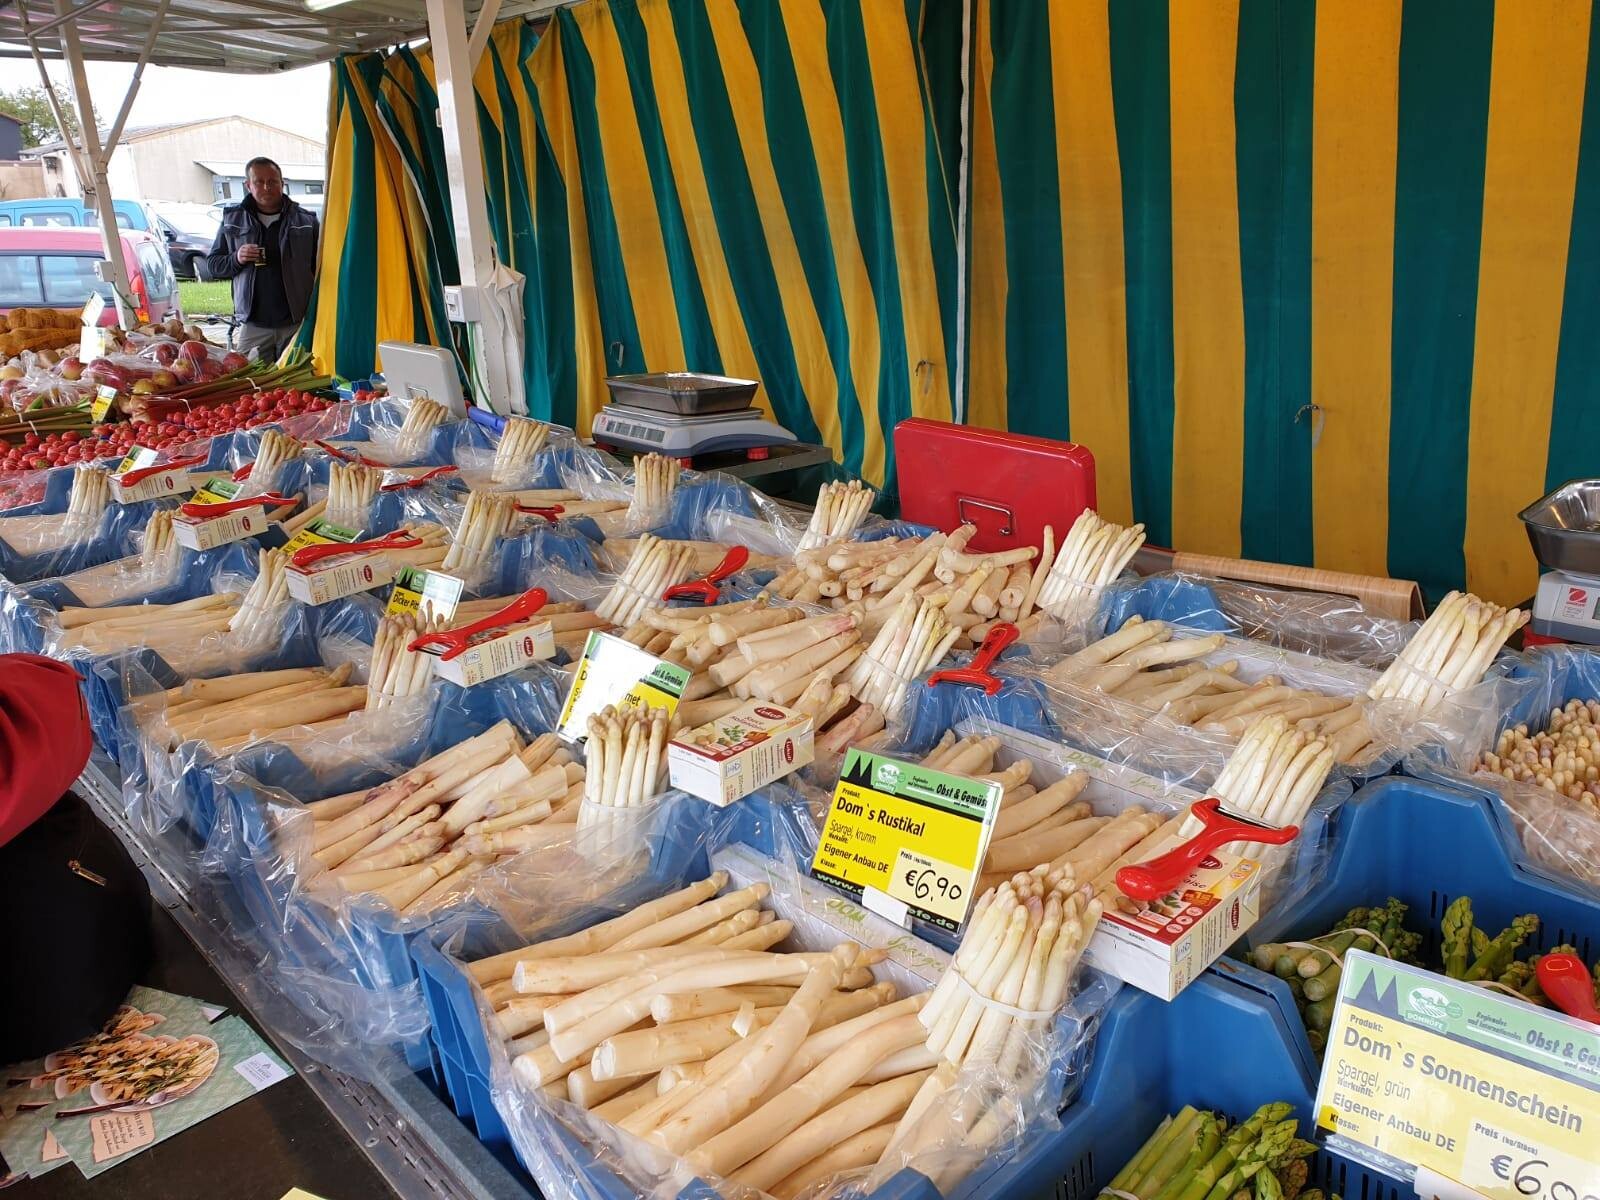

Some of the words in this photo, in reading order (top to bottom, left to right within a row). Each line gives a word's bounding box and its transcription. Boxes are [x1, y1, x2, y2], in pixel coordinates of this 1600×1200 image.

[936, 784, 953, 798] Obst
[954, 788, 961, 799] &
[877, 809, 925, 837] Rustikal
[824, 843, 852, 861] Eigener
[853, 854, 877, 870] Anbau
[878, 862, 889, 873] DE
[905, 869, 962, 902] €6,90
[1350, 1014, 1384, 1033] Produkt:
[1526, 1029, 1560, 1053] Obst
[1562, 1042, 1574, 1058] &
[1337, 1059, 1380, 1091] Spargel,
[1384, 1076, 1411, 1101] grün
[1420, 1055, 1583, 1133] Sonnenschein
[1330, 1113, 1360, 1132] Klasse:
[1333, 1092, 1384, 1122] Eigener
[1387, 1114, 1431, 1143] Anbau
[1436, 1134, 1456, 1153] DE
[1475, 1122, 1498, 1140] Preis
